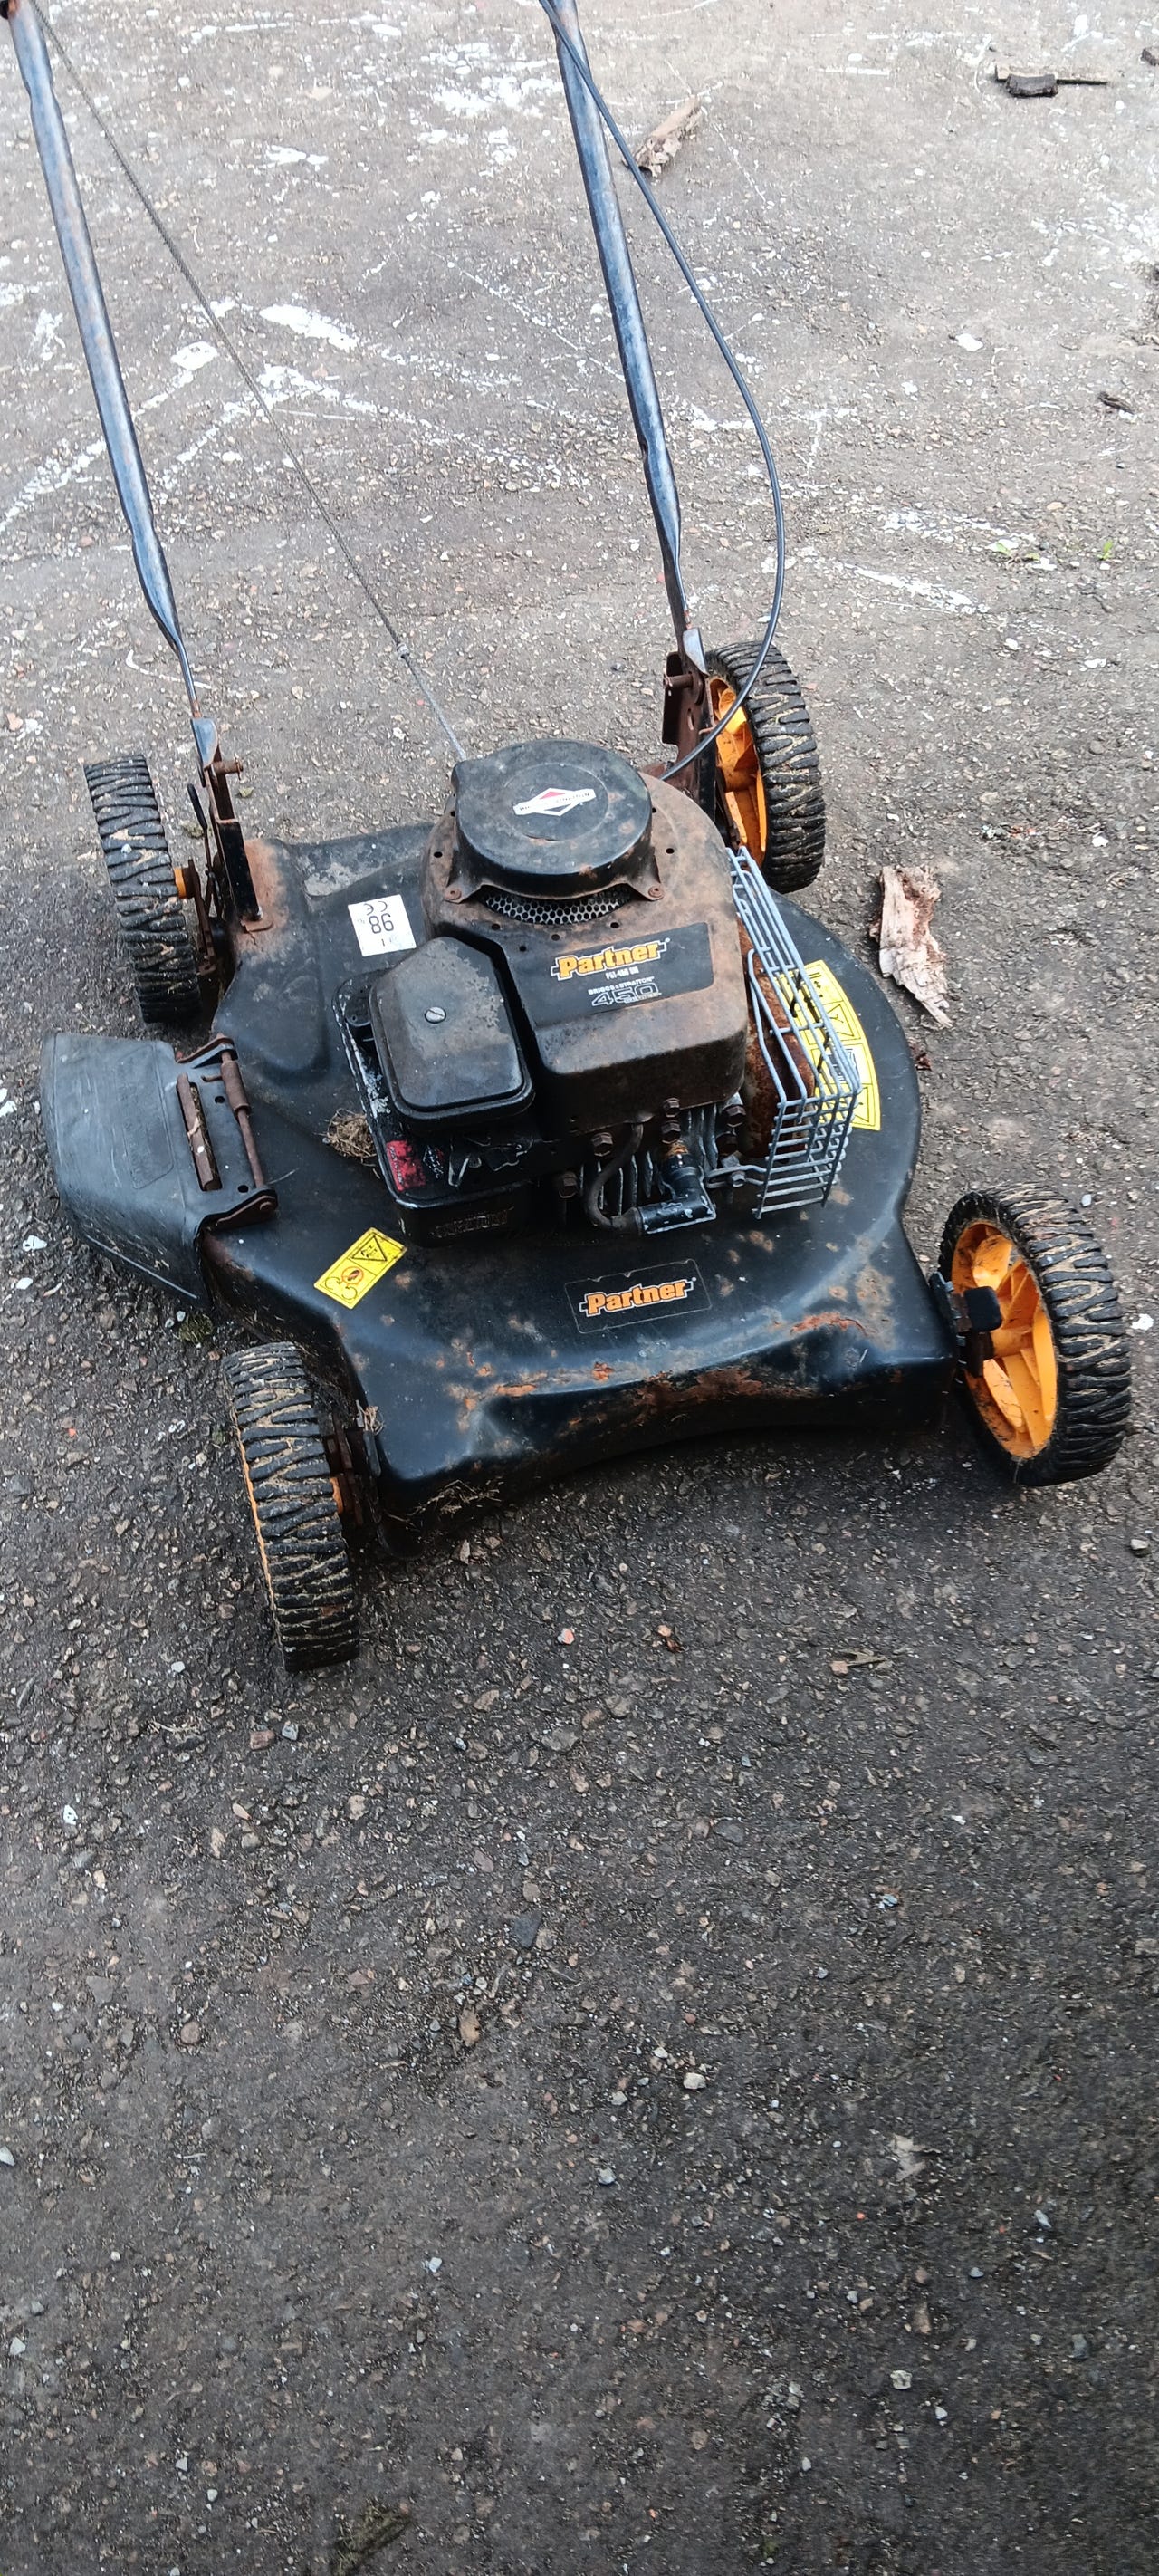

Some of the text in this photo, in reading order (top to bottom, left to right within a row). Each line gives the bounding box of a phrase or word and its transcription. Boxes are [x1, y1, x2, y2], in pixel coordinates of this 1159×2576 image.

[554, 940, 661, 981] Partner
[591, 982, 660, 1006] 450
[584, 1279, 688, 1317] Partner
